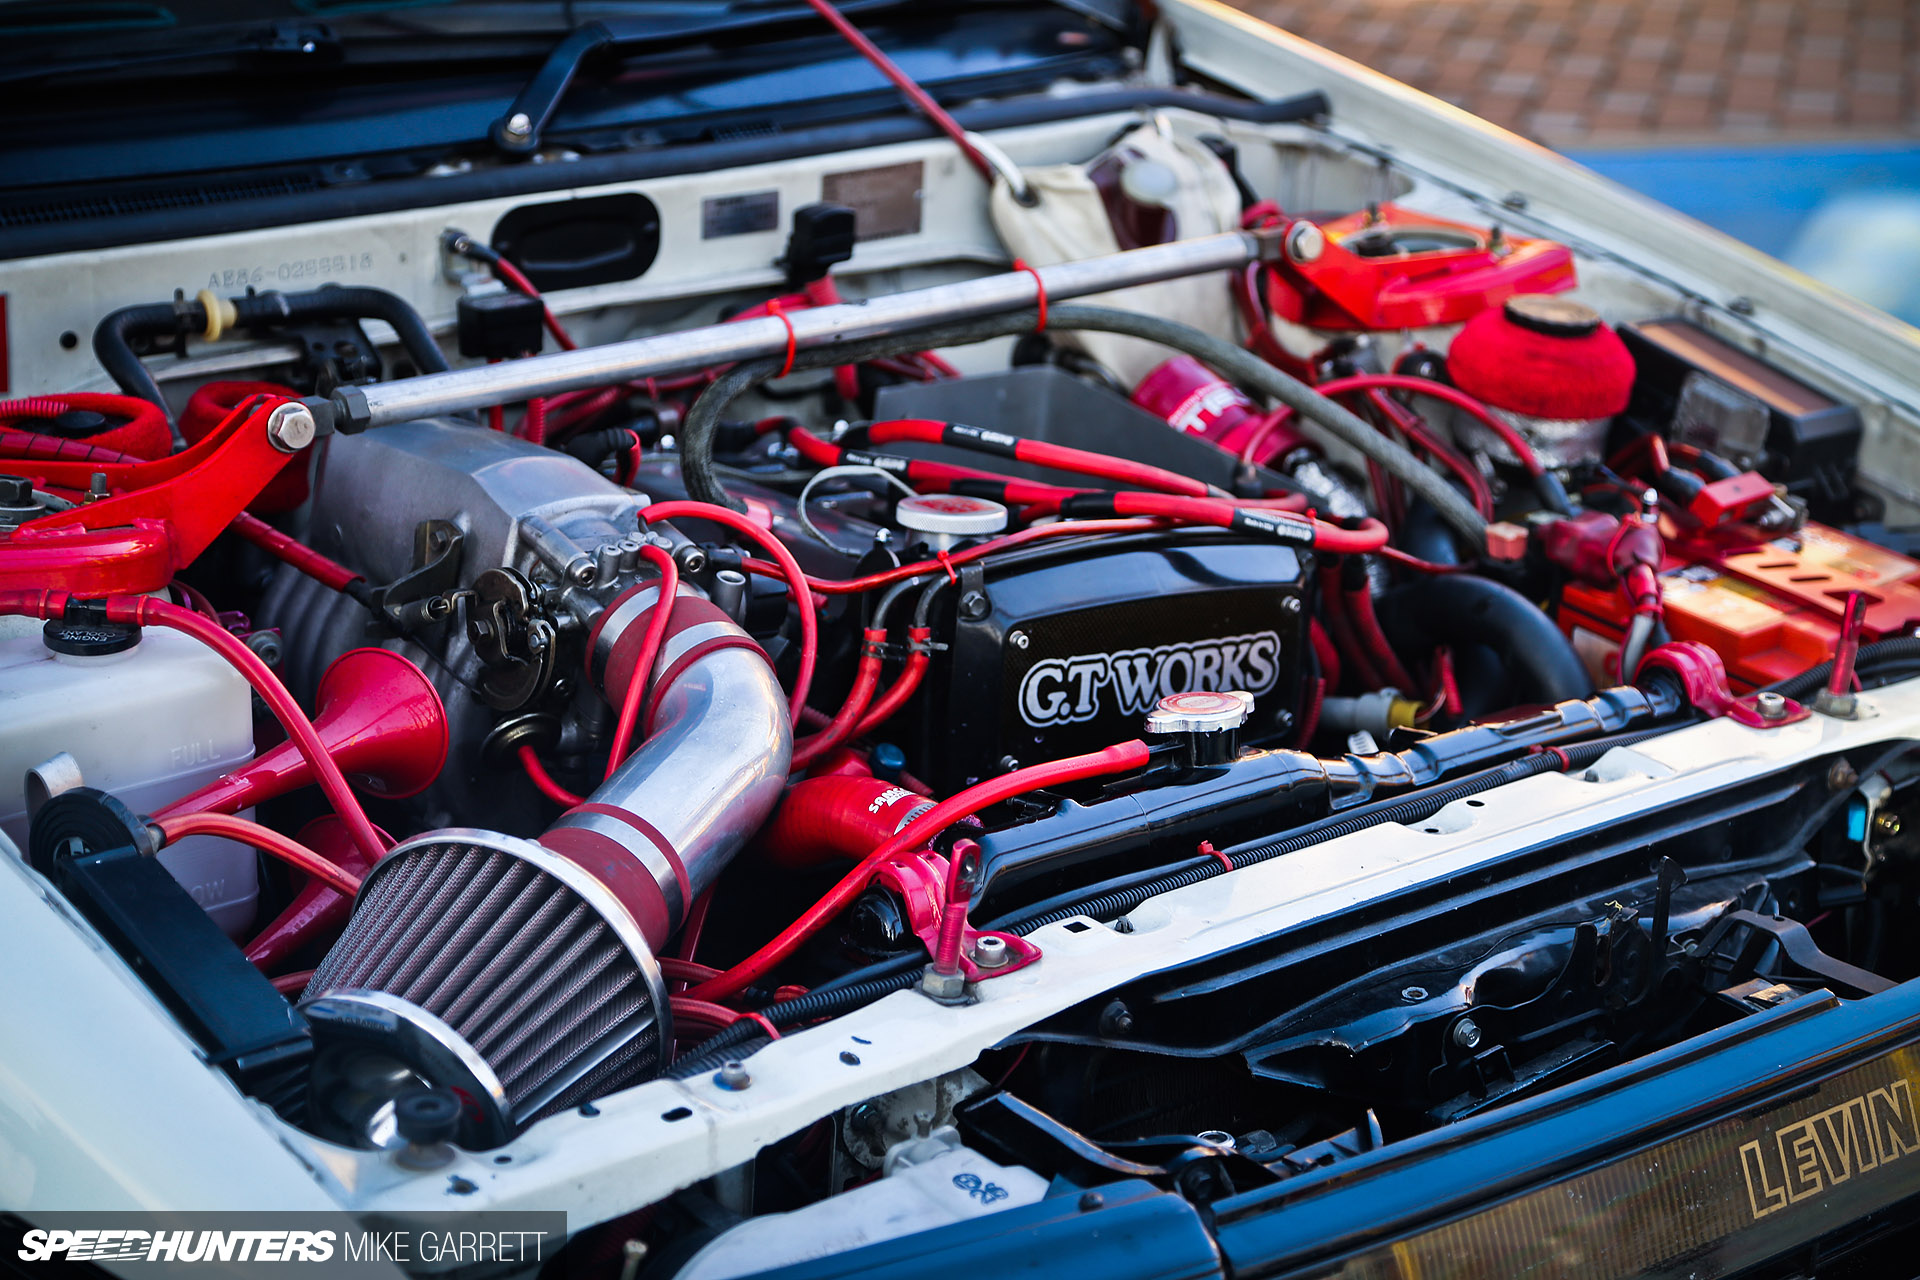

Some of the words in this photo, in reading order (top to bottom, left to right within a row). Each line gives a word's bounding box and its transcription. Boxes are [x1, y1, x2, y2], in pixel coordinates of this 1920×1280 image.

[58, 629, 116, 638] COOLANT
[61, 634, 108, 642] ENGINE
[1110, 631, 1281, 716] WORKS
[170, 739, 221, 770] FULL
[1739, 1078, 1920, 1219] LEVIN
